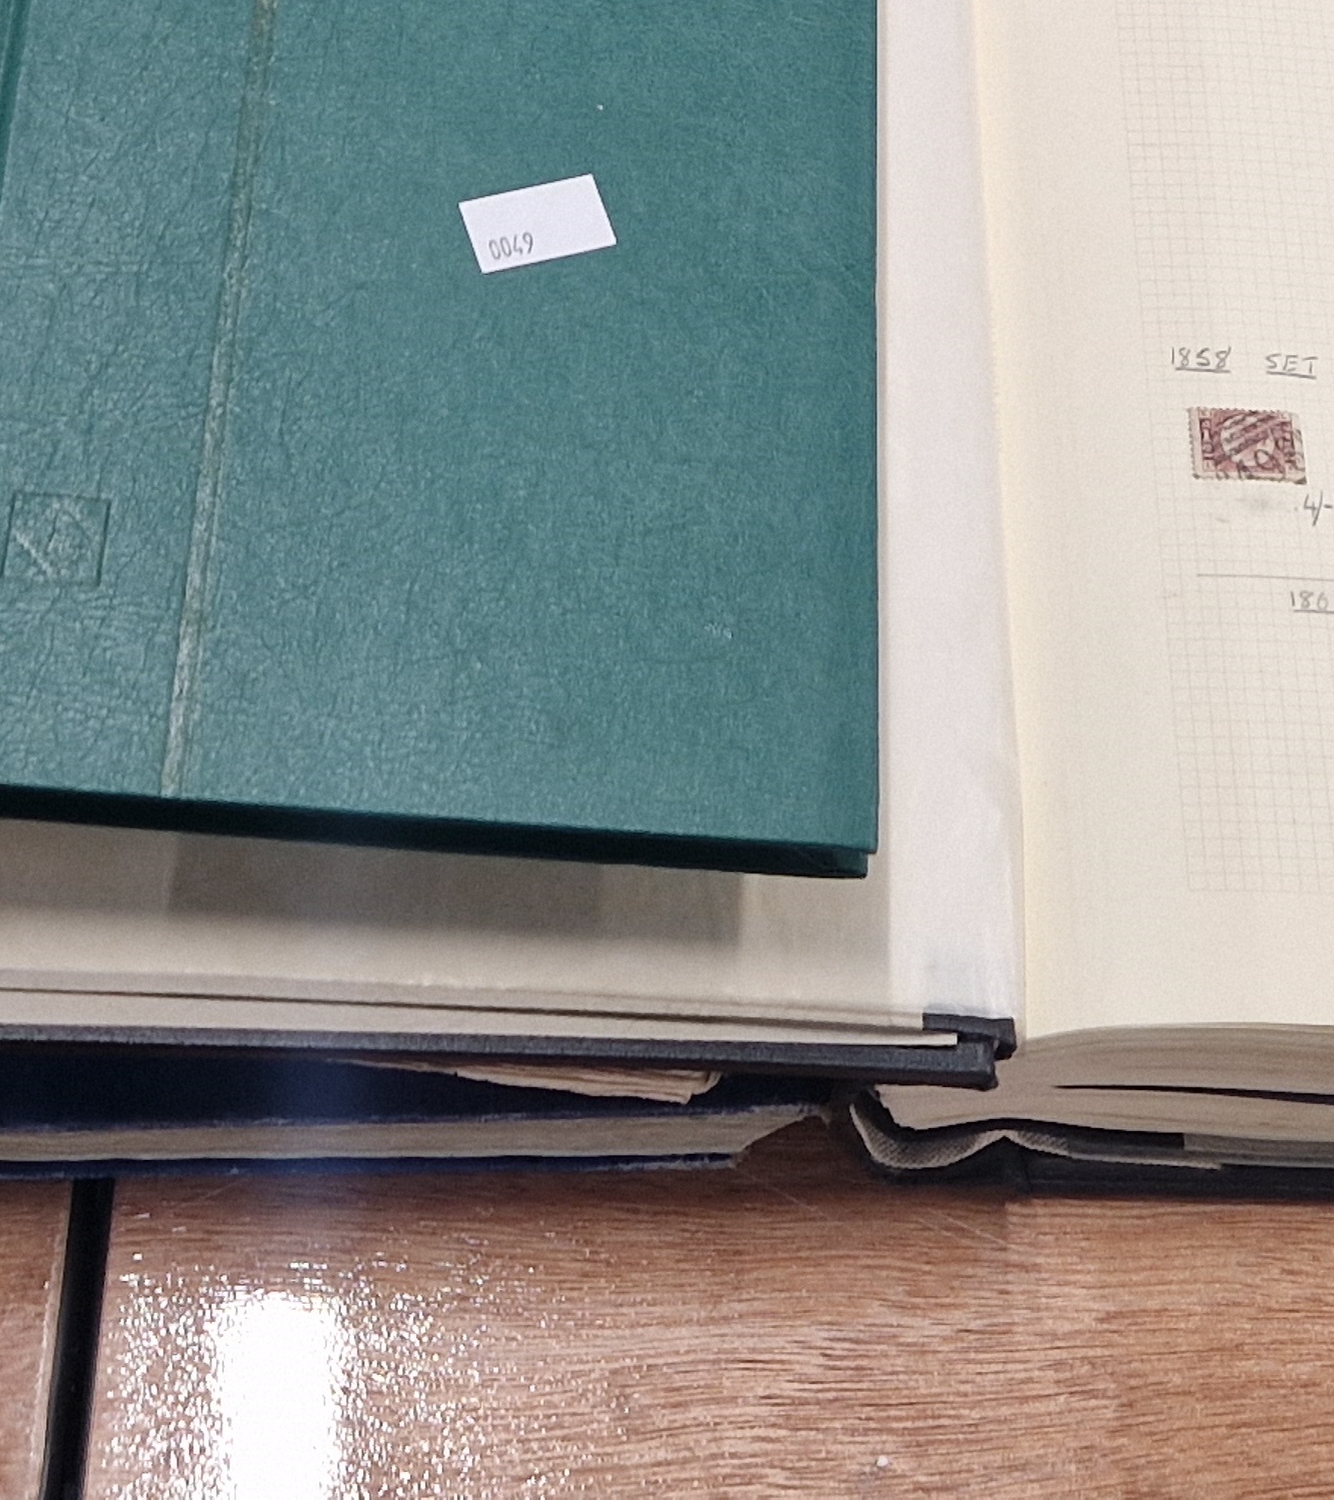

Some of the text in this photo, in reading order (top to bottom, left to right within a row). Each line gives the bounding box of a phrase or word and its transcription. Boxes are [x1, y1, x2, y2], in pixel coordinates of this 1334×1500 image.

[488, 231, 534, 260] 0049
[1170, 347, 1232, 372] 1858
[1266, 353, 1319, 378] SET
